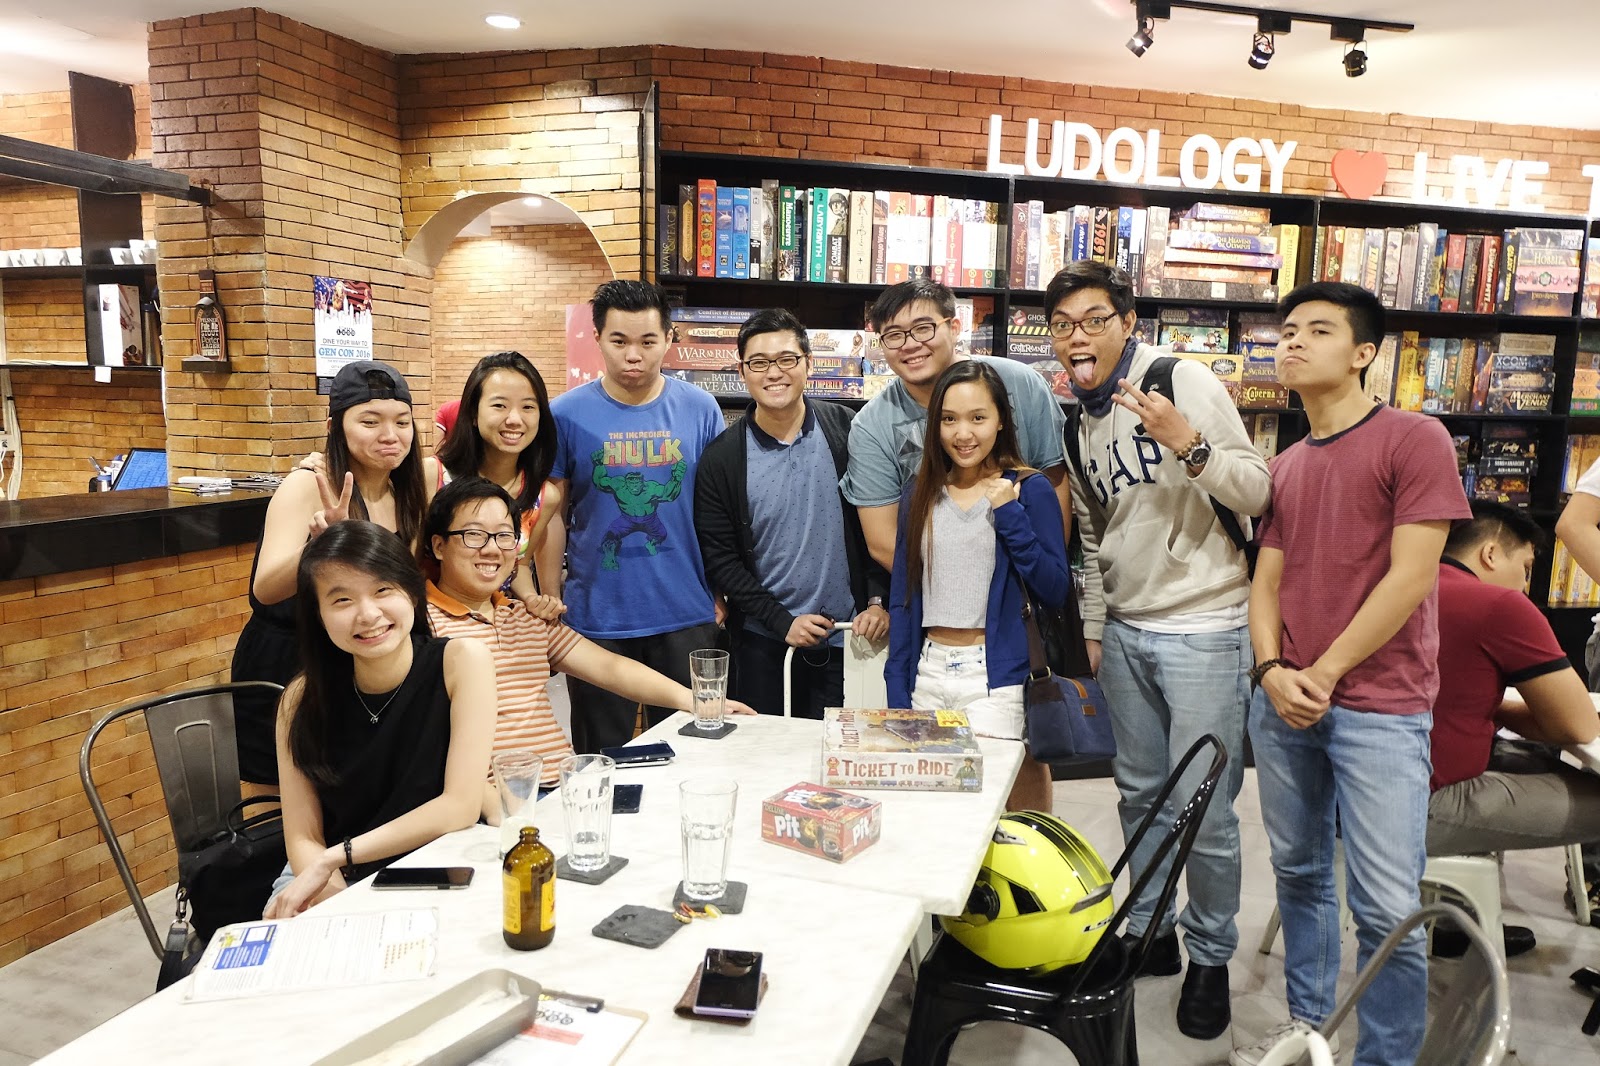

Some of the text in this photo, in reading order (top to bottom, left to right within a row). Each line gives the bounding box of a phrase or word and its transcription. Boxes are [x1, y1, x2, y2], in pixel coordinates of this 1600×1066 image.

[986, 113, 1298, 194] LUDOLOGY
[785, 202, 794, 247] Manoeuvre
[816, 204, 825, 258] LABYRINTH
[1093, 223, 1107, 255] 1989
[1282, 239, 1293, 293] Serenissima
[1365, 246, 1379, 291] TRAINS
[1418, 245, 1429, 305] HEGEMONIC
[319, 348, 371, 359] GEN CON 2016
[677, 347, 706, 361] WAR
[1497, 356, 1527, 366] XCOM
[712, 374, 740, 382] BATTL
[1248, 367, 1276, 377] AGRICOL
[720, 381, 749, 392] ARM
[1247, 387, 1276, 402] Caverna
[1510, 391, 1551, 401] MERCHANT
[1517, 399, 1549, 410] VENUS
[626, 430, 671, 439] INCREDIBLE
[603, 438, 684, 468] HULK
[1085, 435, 1163, 509] GAP
[839, 729, 860, 749] TICKET
[842, 759, 954, 778] TICKET TO RIDE
[774, 814, 801, 839] Pit
[852, 816, 870, 847] Pit
